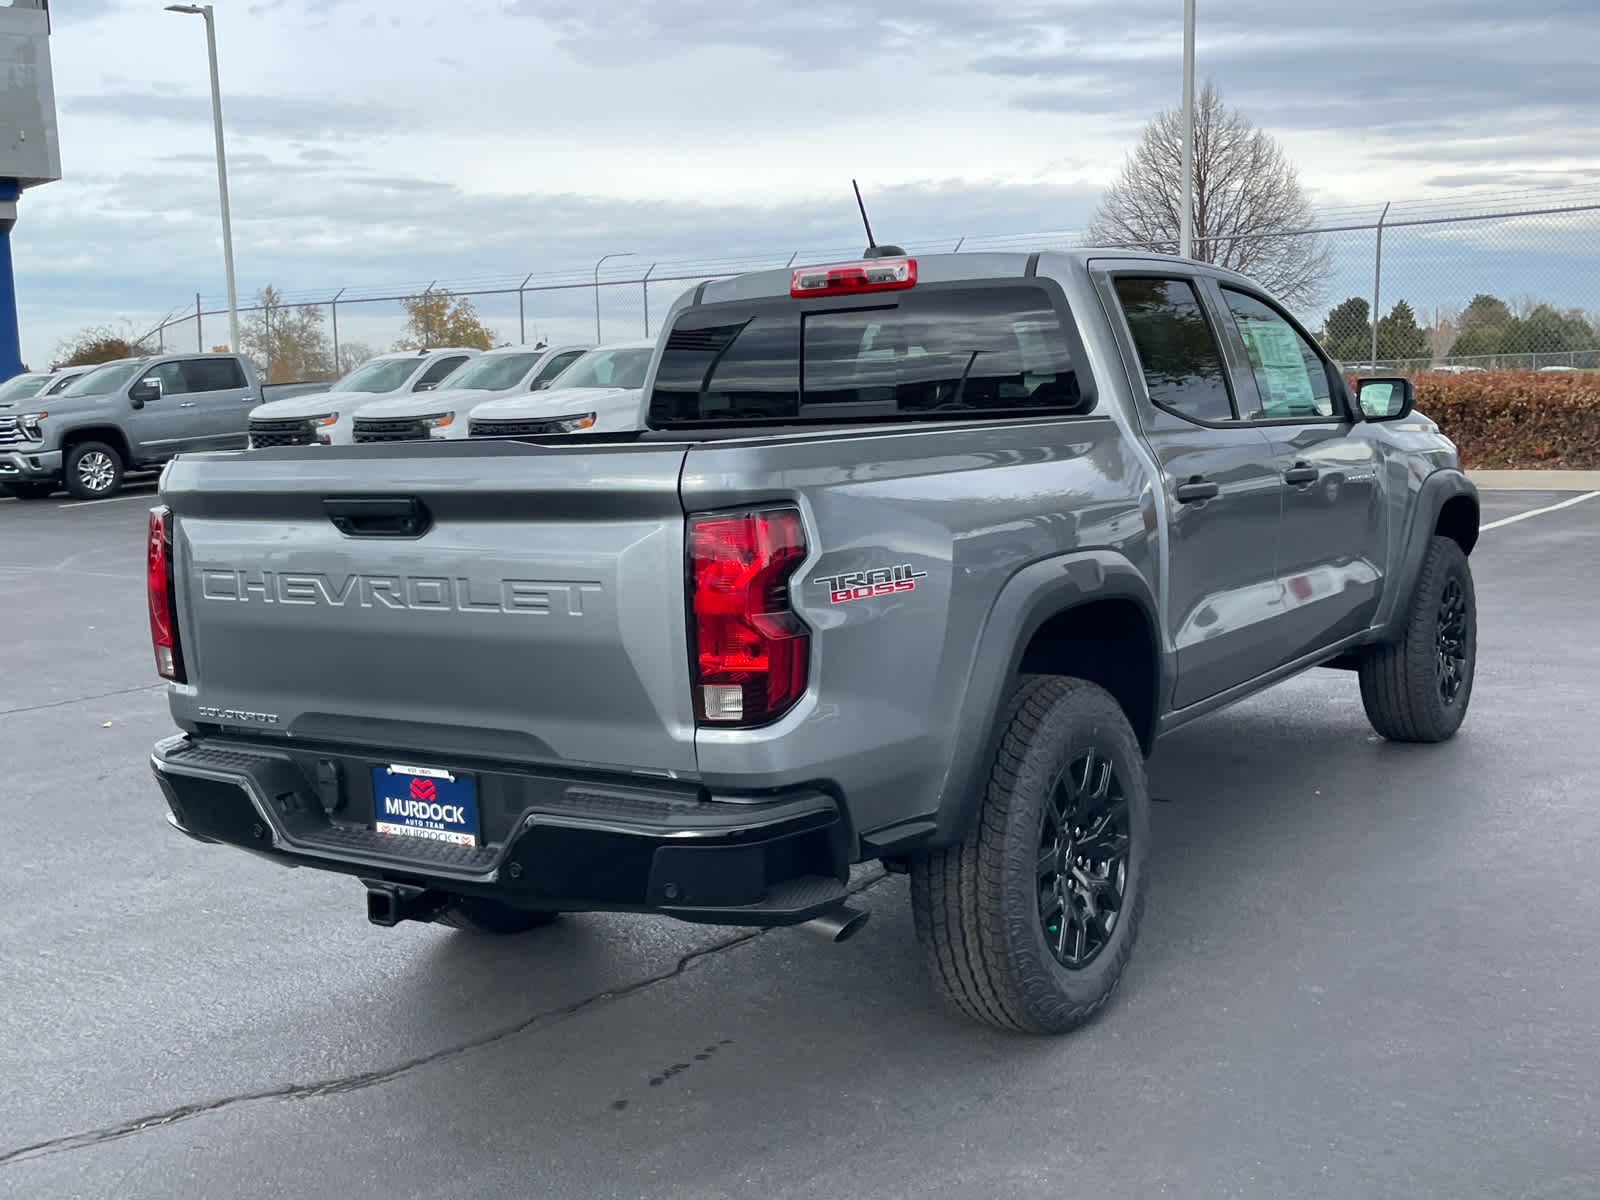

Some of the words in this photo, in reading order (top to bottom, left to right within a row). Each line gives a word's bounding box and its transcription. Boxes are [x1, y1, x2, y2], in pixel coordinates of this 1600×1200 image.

[814, 563, 928, 592] TRAIL
[830, 578, 915, 604] BOSS
[201, 568, 603, 616] CHEVROLET
[385, 797, 466, 824] MURDOCK
[405, 818, 423, 827] AUTO
[425, 819, 445, 830] TEAM
